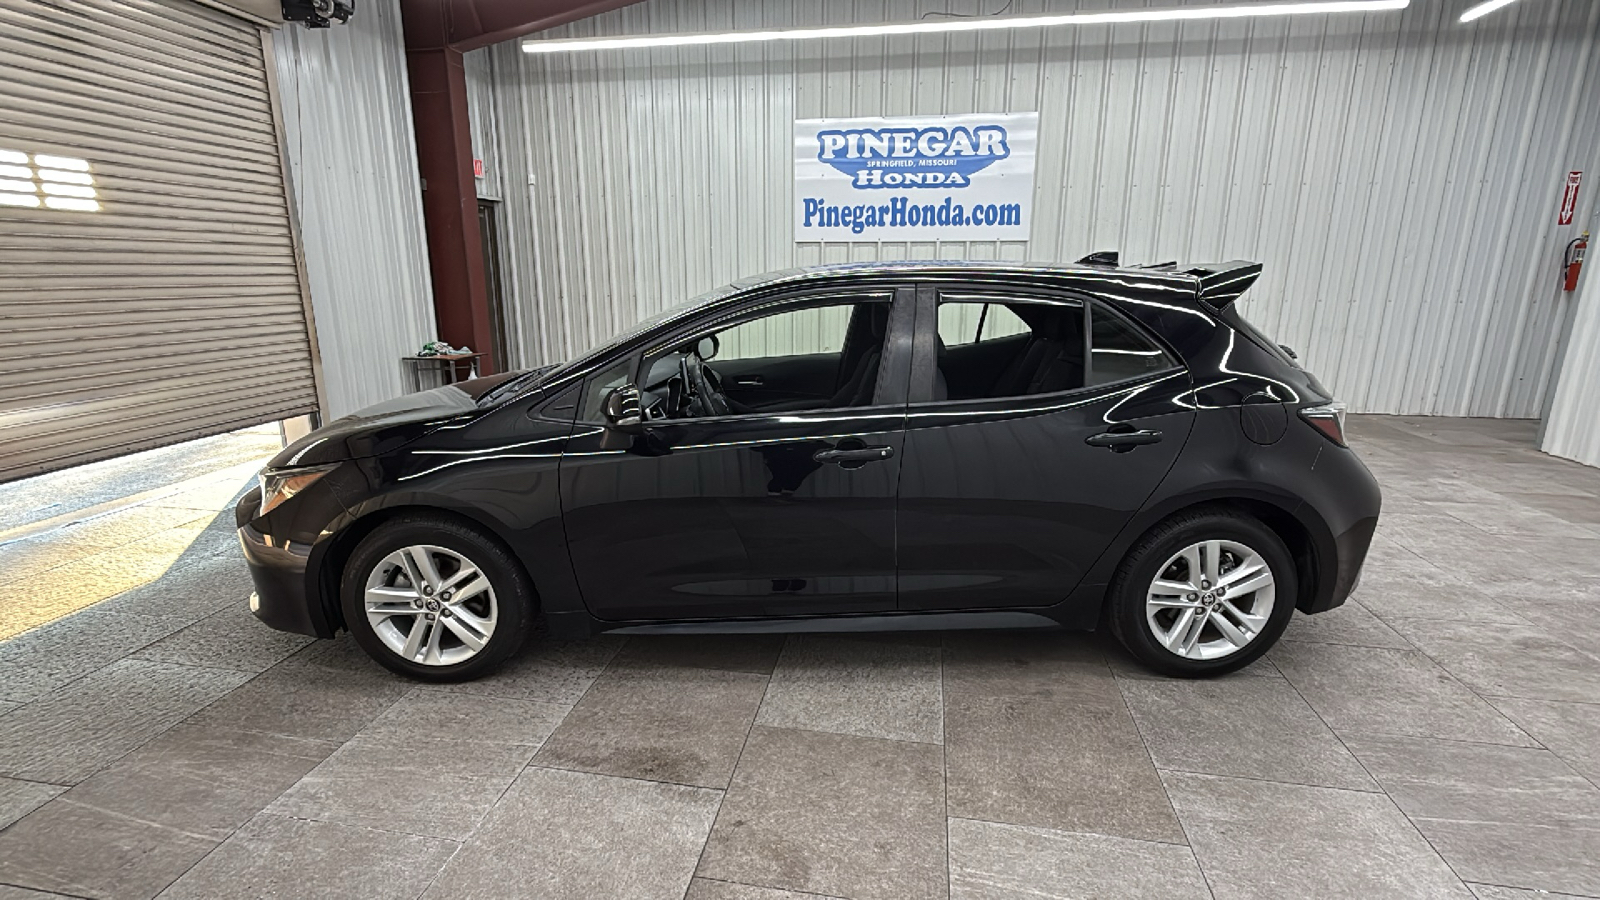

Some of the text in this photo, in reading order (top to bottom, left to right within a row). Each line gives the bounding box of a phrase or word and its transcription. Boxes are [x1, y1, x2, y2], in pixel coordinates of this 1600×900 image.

[820, 129, 1006, 159] PINEGAR
[918, 159, 958, 167] MISSOURI
[855, 169, 967, 186] HONDA
[802, 196, 1021, 234] PinegarHonda.com
